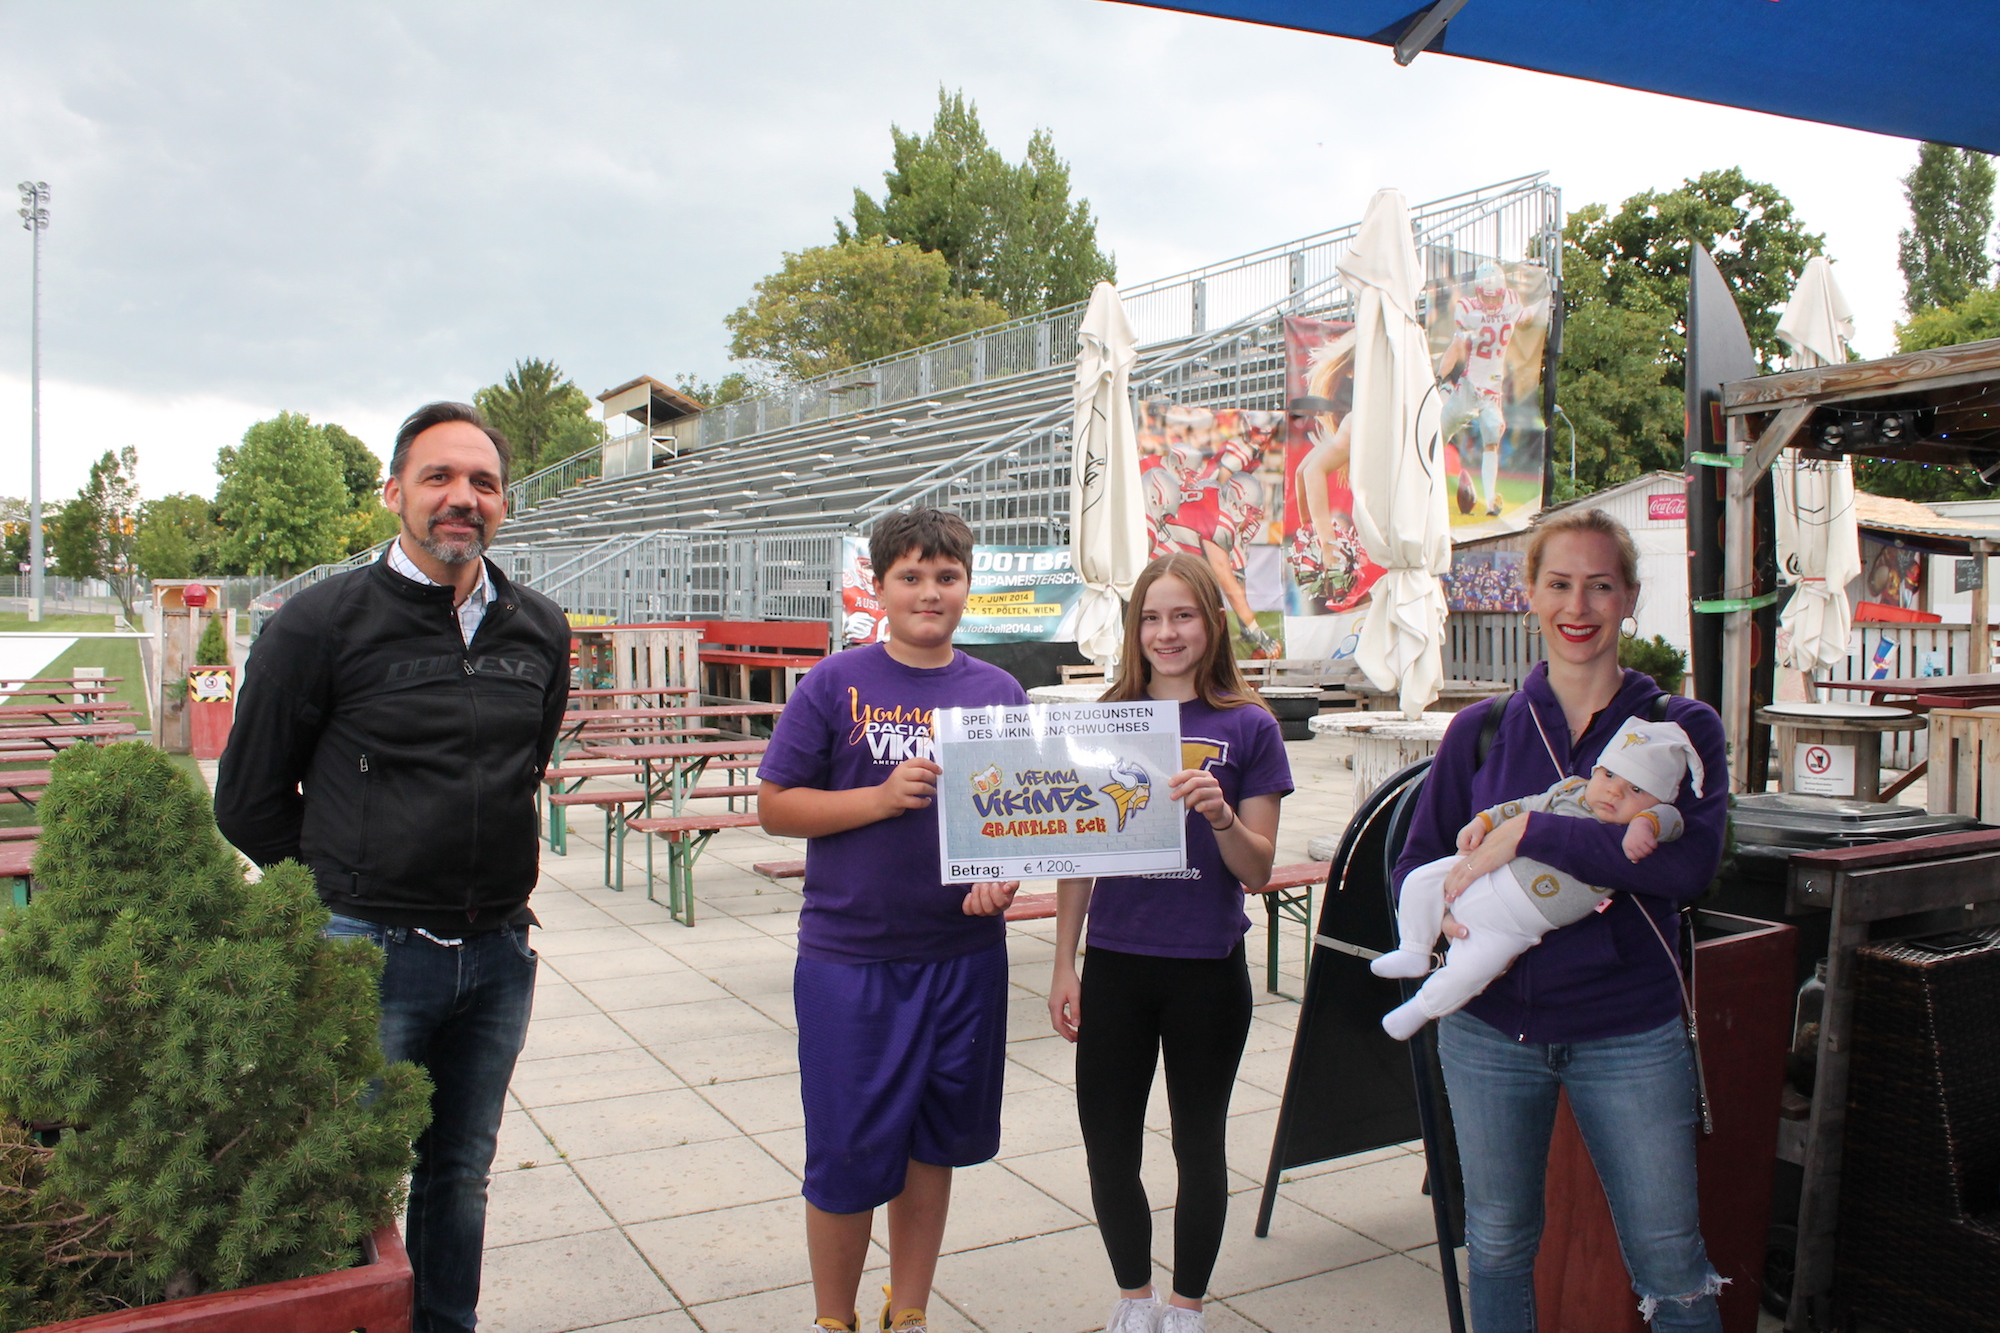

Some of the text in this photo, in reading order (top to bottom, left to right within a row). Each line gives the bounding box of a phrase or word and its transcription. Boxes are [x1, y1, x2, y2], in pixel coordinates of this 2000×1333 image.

[972, 552, 1072, 572] OOTBA
[971, 572, 1082, 587] ROPAMEISTERSCH
[855, 596, 879, 611] AUST
[987, 595, 1007, 603] JUNI
[982, 607, 994, 615] ST.
[955, 623, 1044, 634] w.football2014.at
[1074, 707, 1154, 720] ZUGUNSTEN
[866, 722, 930, 736] DACIA
[967, 728, 993, 740] DES
[865, 732, 938, 761] VIKIN
[951, 864, 1004, 878] Betrag:
